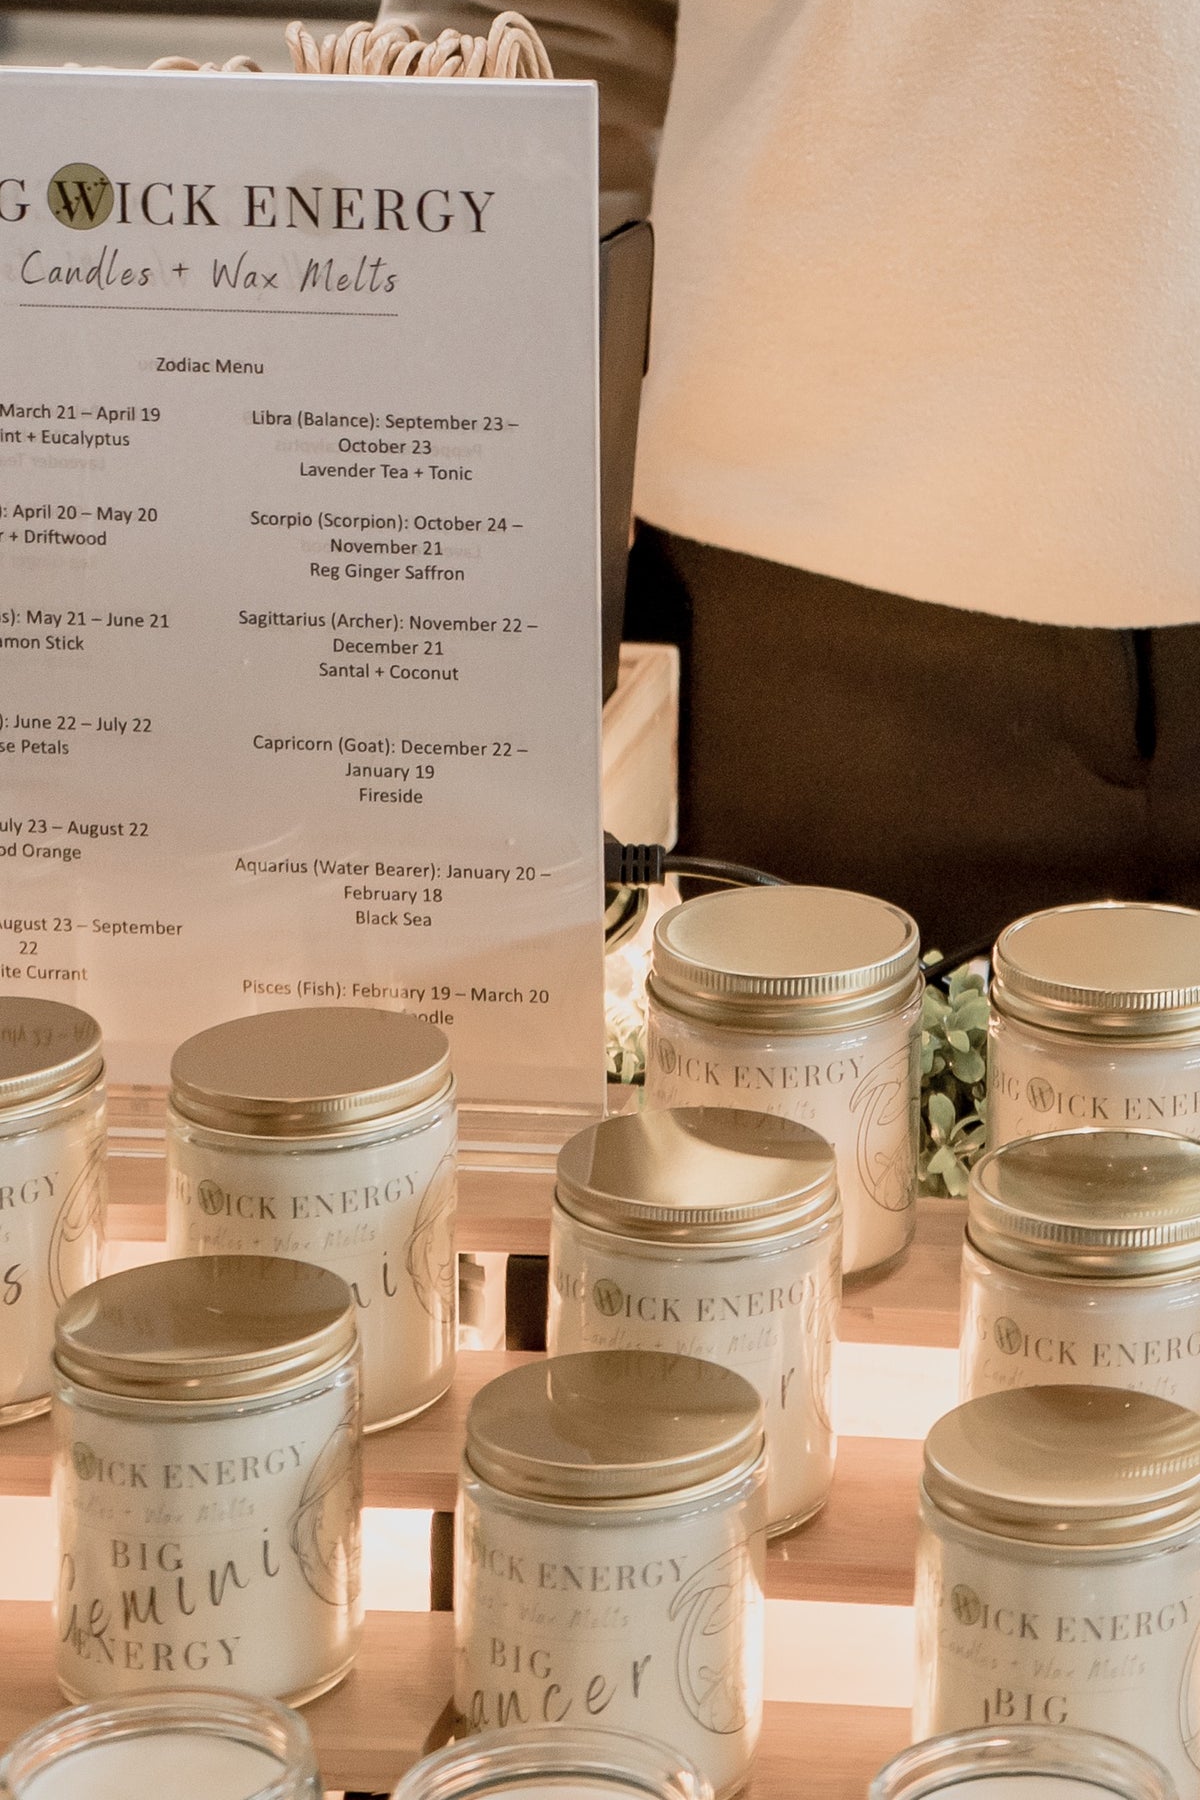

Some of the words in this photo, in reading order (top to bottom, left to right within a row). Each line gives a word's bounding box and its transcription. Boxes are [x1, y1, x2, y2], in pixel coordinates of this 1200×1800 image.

[54, 178, 221, 228] WICK
[243, 184, 496, 234] ENERGY
[20, 244, 152, 291] Candles
[212, 250, 279, 290] Wax
[299, 254, 398, 294] Melts
[155, 356, 211, 374] Zodiac
[215, 358, 265, 375] Menu
[0, 402, 52, 419] March
[56, 404, 77, 420] 21
[95, 405, 136, 425] April
[141, 407, 161, 423] 19
[251, 409, 293, 426] Libra
[297, 410, 380, 431] (Balance):
[385, 413, 478, 432] September
[482, 415, 504, 432] 23
[41, 429, 131, 449] Eucalyptus
[337, 437, 407, 455] October
[411, 439, 433, 456] 23
[299, 462, 377, 479] Lavender
[379, 463, 409, 480] Tea
[428, 464, 473, 482] Tonic
[12, 503, 52, 522] April
[56, 504, 78, 521] 20
[96, 506, 134, 525] May
[137, 506, 159, 523] 20
[250, 510, 313, 530] Scorpio
[317, 511, 409, 533] (Scorpion):
[413, 514, 483, 532] October
[487, 517, 508, 533] 24
[24, 528, 107, 546] Driftwood
[330, 538, 418, 555] November
[422, 540, 444, 556] 21
[309, 561, 341, 582] Reg
[344, 563, 401, 583] Ginger
[404, 564, 465, 581] Saffron
[26, 609, 63, 628] May
[66, 610, 87, 627] 21
[106, 612, 145, 628] June
[149, 613, 170, 629] 21
[238, 609, 327, 629] Sagittarius
[330, 611, 404, 633] (Archer):
[409, 615, 498, 633] November
[502, 617, 523, 634] 22
[45, 634, 84, 651] Stick
[332, 637, 419, 656] December
[423, 640, 444, 656] 21
[318, 661, 370, 679] Santal
[389, 664, 459, 681] Coconut
[13, 714, 52, 730] June
[56, 715, 77, 731] 22
[96, 716, 128, 736] July
[132, 717, 152, 733] 22
[20, 738, 70, 756] Petals
[252, 734, 333, 753] Capricorn
[338, 736, 396, 757] (Goat):
[401, 739, 488, 757] December
[492, 741, 512, 758] 22
[345, 762, 410, 782] January
[415, 764, 435, 780] 19
[359, 787, 424, 805] Fireside
[0, 817, 23, 836] uly
[27, 818, 48, 834] 23
[67, 820, 124, 839] August
[129, 821, 149, 838] 22
[21, 842, 82, 863] Orange
[234, 857, 309, 876] Aquarius
[313, 858, 370, 877] (Water
[374, 861, 441, 882] Bearer):
[446, 864, 511, 884] January
[515, 865, 536, 882] 20
[343, 885, 418, 905] February
[423, 887, 443, 903] 18
[53, 916, 73, 933] 23
[92, 918, 183, 937] September
[355, 909, 398, 926] Black
[402, 911, 433, 927] Sea
[19, 940, 38, 956] 22
[25, 964, 87, 981] Currant
[242, 979, 292, 995] Pisces
[296, 980, 346, 1001] (Fish):
[352, 982, 426, 1003] February
[430, 985, 452, 1001] 19
[470, 986, 524, 1003] March
[528, 988, 550, 1005] 20
[733, 1055, 864, 1090] ENERGY
[290, 1170, 420, 1220] ENERGY
[697, 1274, 818, 1323] ENERGY
[163, 1440, 306, 1490] ENERGY
[111, 1538, 184, 1573] BIG
[538, 1555, 689, 1593] ENERGY
[1055, 1596, 1192, 1643] ENERGY
[490, 1637, 551, 1680] BIG
[995, 1687, 1069, 1725] BIG
